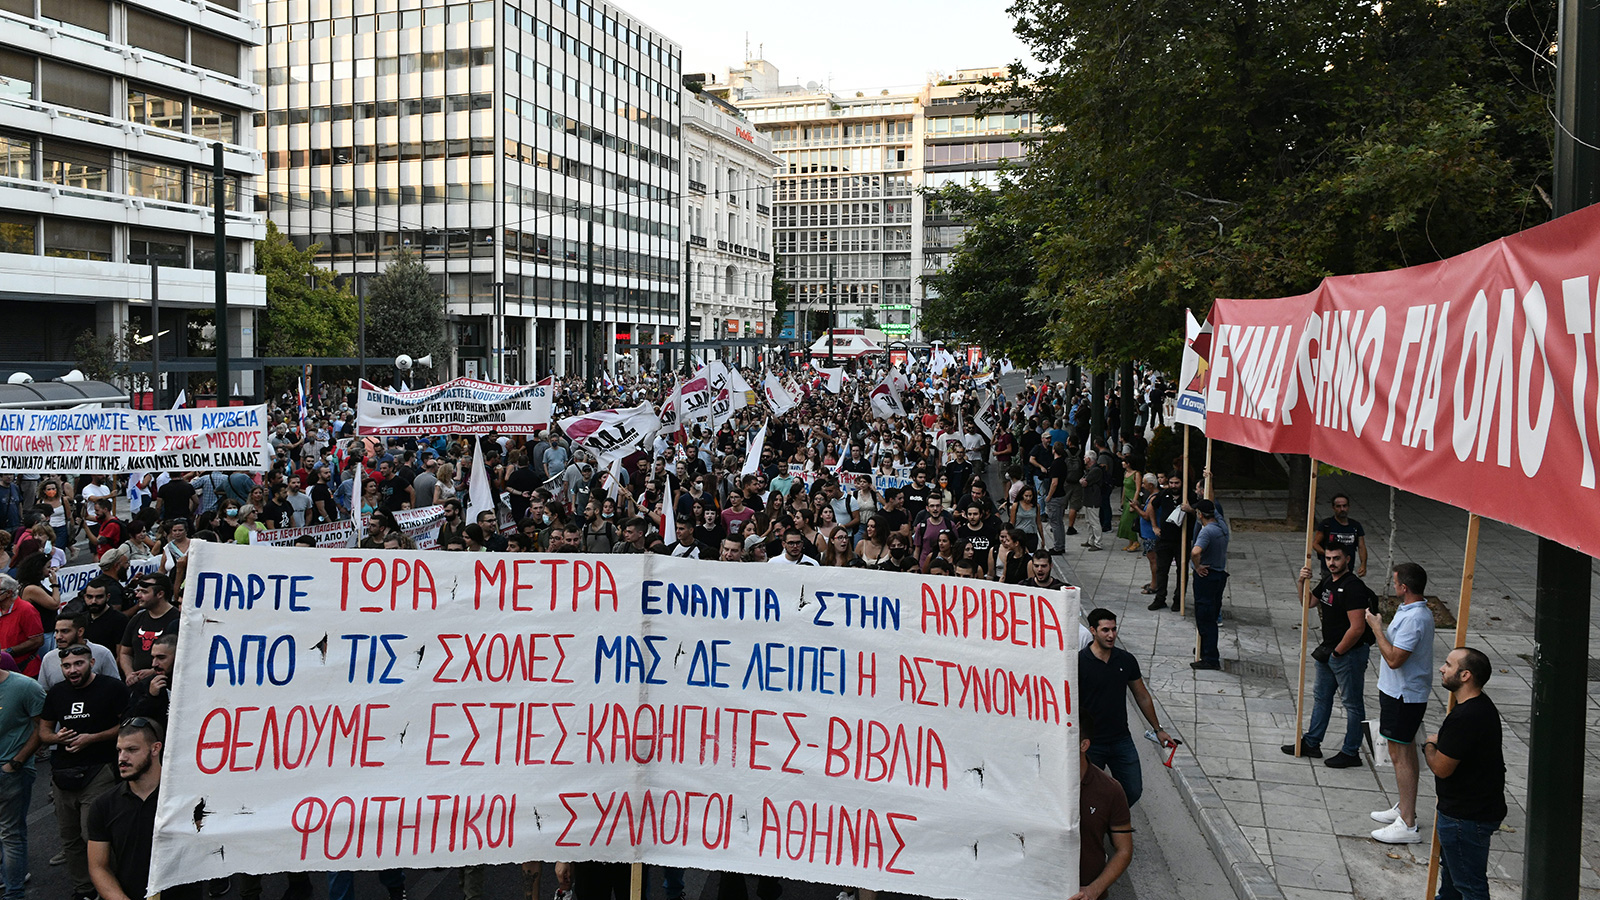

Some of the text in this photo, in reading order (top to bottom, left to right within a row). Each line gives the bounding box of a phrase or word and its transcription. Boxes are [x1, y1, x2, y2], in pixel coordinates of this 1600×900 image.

[736, 127, 754, 143] Public
[1207, 324, 1292, 423] ΕΥΜΑ
[1382, 300, 1451, 452] ΓΙΑ
[1452, 280, 1554, 479] ΟΛΟ
[1561, 274, 1600, 490] Τ
[367, 392, 382, 403] ΔΕΝ
[524, 387, 545, 398] PASS
[381, 407, 397, 416] ΣΤΑ
[426, 402, 442, 412] ΤΗΣ
[443, 401, 488, 412] ΚΥΒΕΡΝΗΣΗΣ
[489, 400, 532, 412] ΑΠΑΝΤΑΜΕ
[0, 414, 25, 431] ΔΕΝ
[29, 413, 130, 431] ΣΥΜΒΙΒΑΖΟΜΑΣΤΕ
[137, 415, 160, 431] ΜΕ
[164, 414, 193, 431] ΤΗΝ
[408, 415, 422, 424] ΜΕ
[379, 426, 438, 435] ΣΥΝΔΙΚΑΤΟ
[496, 425, 534, 433] ΑΘΗΝΑΣ
[0, 431, 261, 452] ΥΠΟΓΡΑΦΗ ΣΣΕ ΜΕ ΑΥΞΗΣΕΙΣ ΣΤΟΥΣ ΜΙΣΘΟΥΣ
[0, 456, 43, 470] ΣΥΝΔΙΚΑΤΟ
[44, 456, 83, 470] ΜΕΤΑΛΛΟΥ
[84, 456, 120, 470] ΑΤΤΙΚΗΣ
[214, 452, 262, 467] ΕΛΛΑΔΑΣ
[888, 477, 898, 489] ΝΑ
[279, 527, 302, 539] ΛΕΦΤΑ
[303, 525, 313, 535] ΓΙΑ
[314, 522, 342, 533] ΠΑΙΔΕΙΑ
[342, 520, 351, 529] ΚΑ
[411, 509, 425, 519] ΝΑΤΟ
[324, 532, 342, 541] ΑΠΟ
[421, 512, 445, 525] ΠΟΛΕΜ
[195, 572, 314, 612] ΠΑΡΤΕ
[330, 557, 437, 612] ΤΩΡΑ
[475, 559, 618, 612] ΜΕΤΡΑ
[642, 580, 781, 623] ΕΝΑΝΤΙΑ
[813, 592, 900, 631] ΣΤΗΝ
[921, 583, 1064, 652] ΑΚΡΙΒΕΙΑ
[206, 633, 1073, 728] ΑΠΟ ΤΙΣ ΣΧΟΛΕΣ ΜΑΣ ΔΕ ΛΕΙΠΕΙ Η ΑΣΤΥΝΟΜΙΑ!
[196, 704, 390, 774] ΘΕΛΟΥΜΕ
[292, 790, 918, 874] ΦΟΙΤΗΤΙΚΟΙ ΣΥΛΛΟΓΟΙ ΑΘΗΝΑΣ
